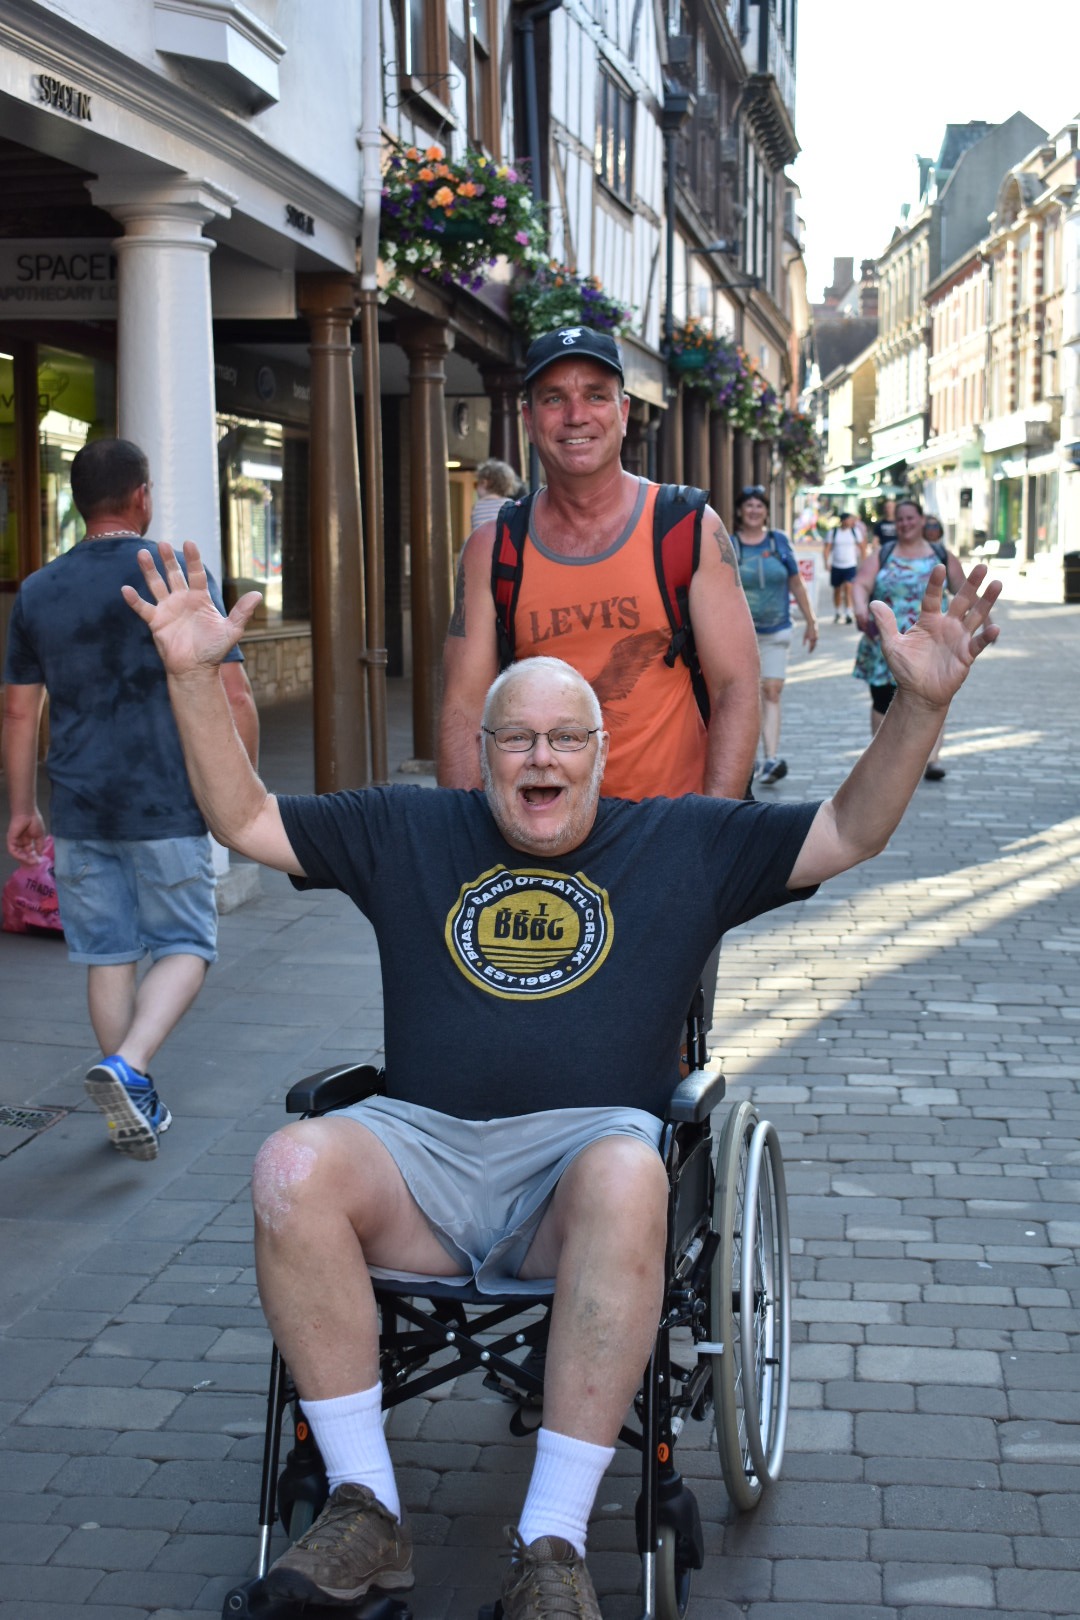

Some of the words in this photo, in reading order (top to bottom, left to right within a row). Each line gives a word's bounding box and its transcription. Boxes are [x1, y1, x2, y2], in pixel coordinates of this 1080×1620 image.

[529, 595, 640, 645] LEVI'S
[26, 878, 54, 898] TRADE
[461, 906, 480, 961] BRASS
[471, 880, 513, 905] BAND
[515, 876, 541, 886] OF
[539, 877, 594, 908] BATTL
[571, 908, 595, 965] CREEK
[483, 965, 518, 983] EST
[519, 969, 563, 986] 1989
